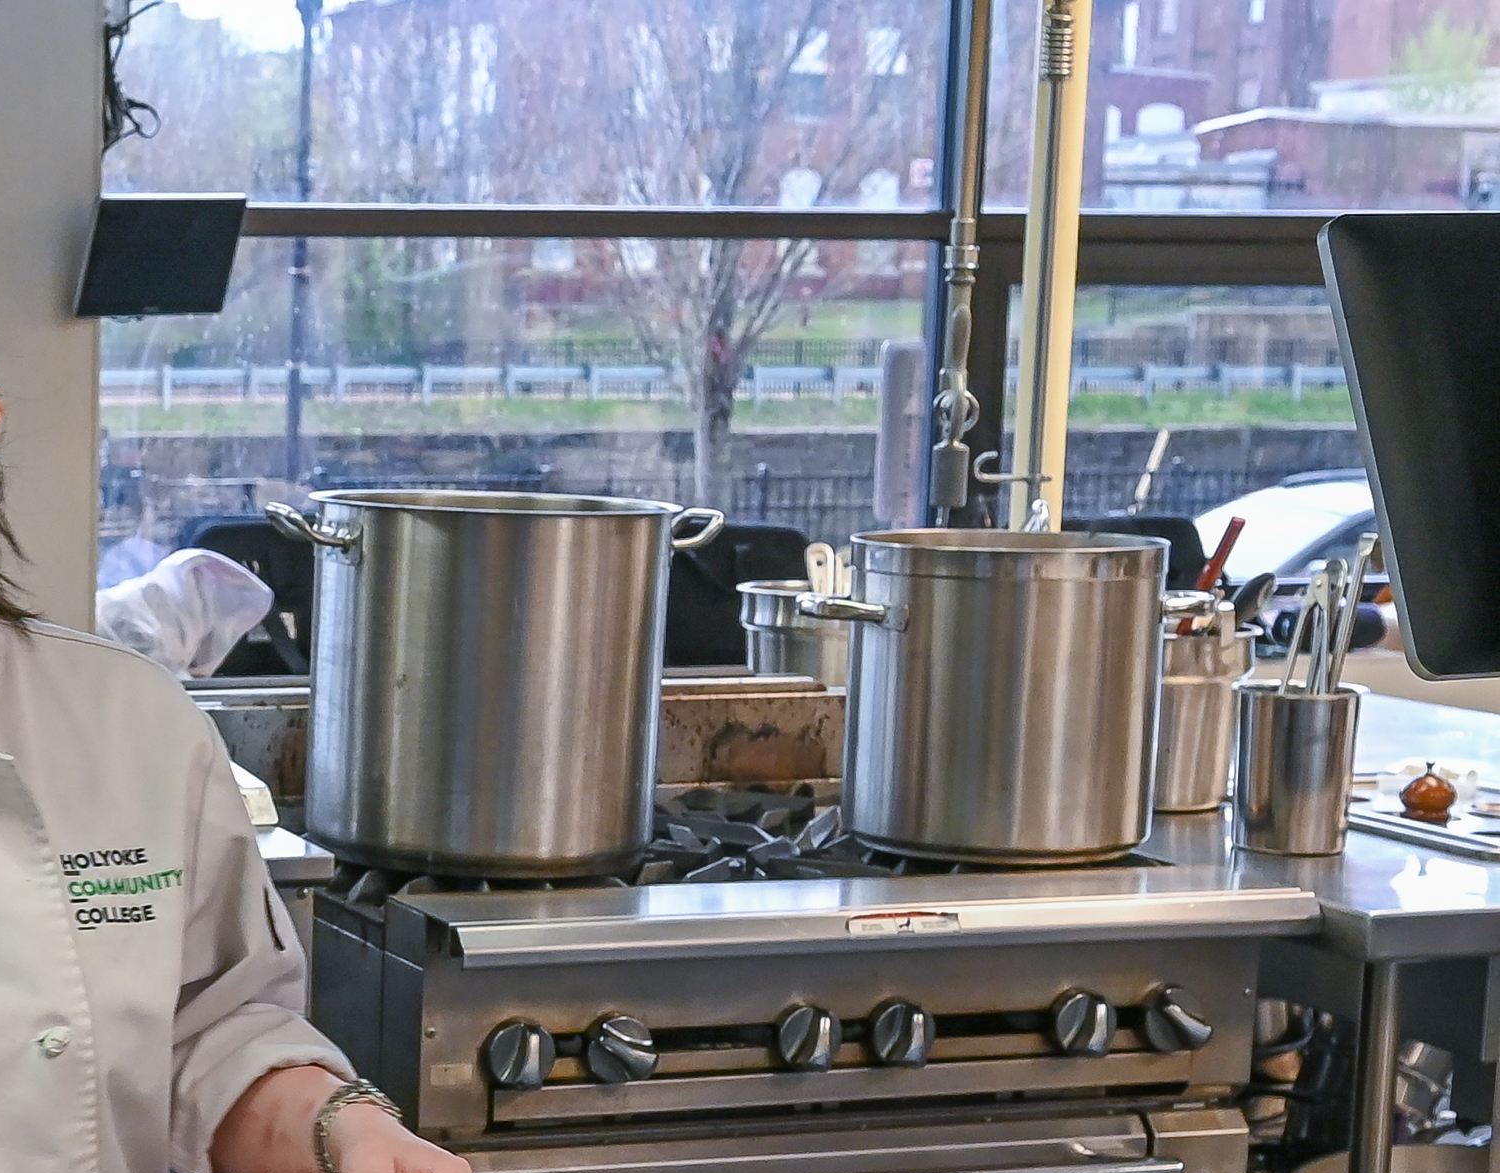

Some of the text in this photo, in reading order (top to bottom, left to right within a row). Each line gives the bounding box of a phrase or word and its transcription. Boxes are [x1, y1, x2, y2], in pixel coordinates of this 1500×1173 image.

[60, 848, 149, 870] HOLYOKE
[67, 869, 184, 897] COMMUNITY
[75, 905, 157, 925] COLLEGE
